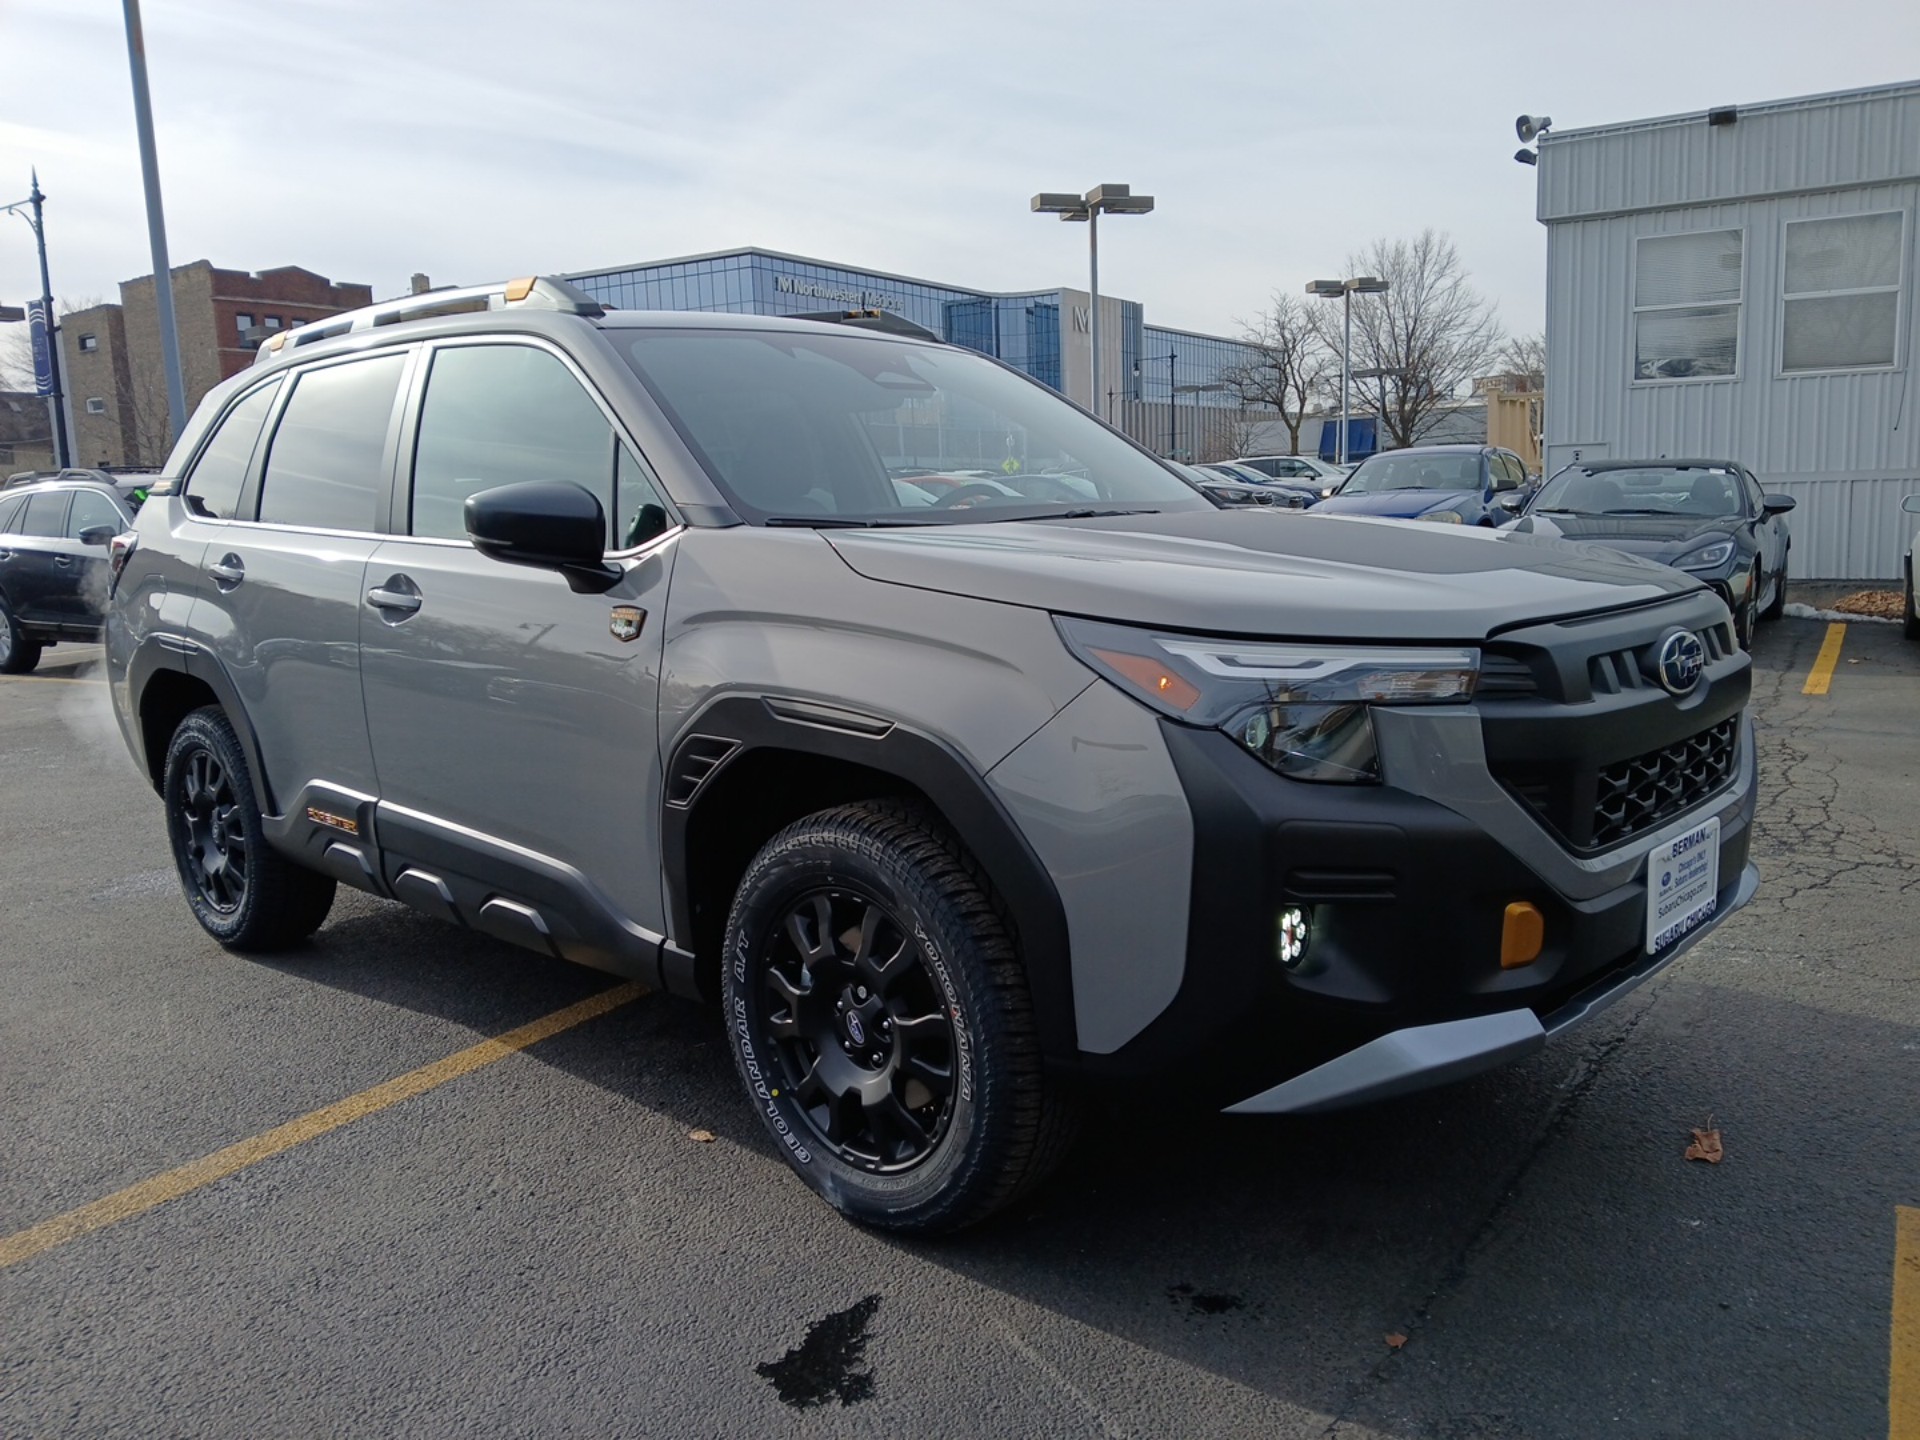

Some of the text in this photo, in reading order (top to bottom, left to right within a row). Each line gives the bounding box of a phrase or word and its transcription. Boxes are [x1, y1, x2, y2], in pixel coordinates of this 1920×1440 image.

[794, 279, 862, 304] Northwestern
[1672, 826, 1706, 858] BERMAN
[1658, 880, 1708, 919] SubaruChicago.com
[914, 921, 972, 1101] YOKOHAMA
[734, 929, 811, 1163] GEOLANDAR A/T
